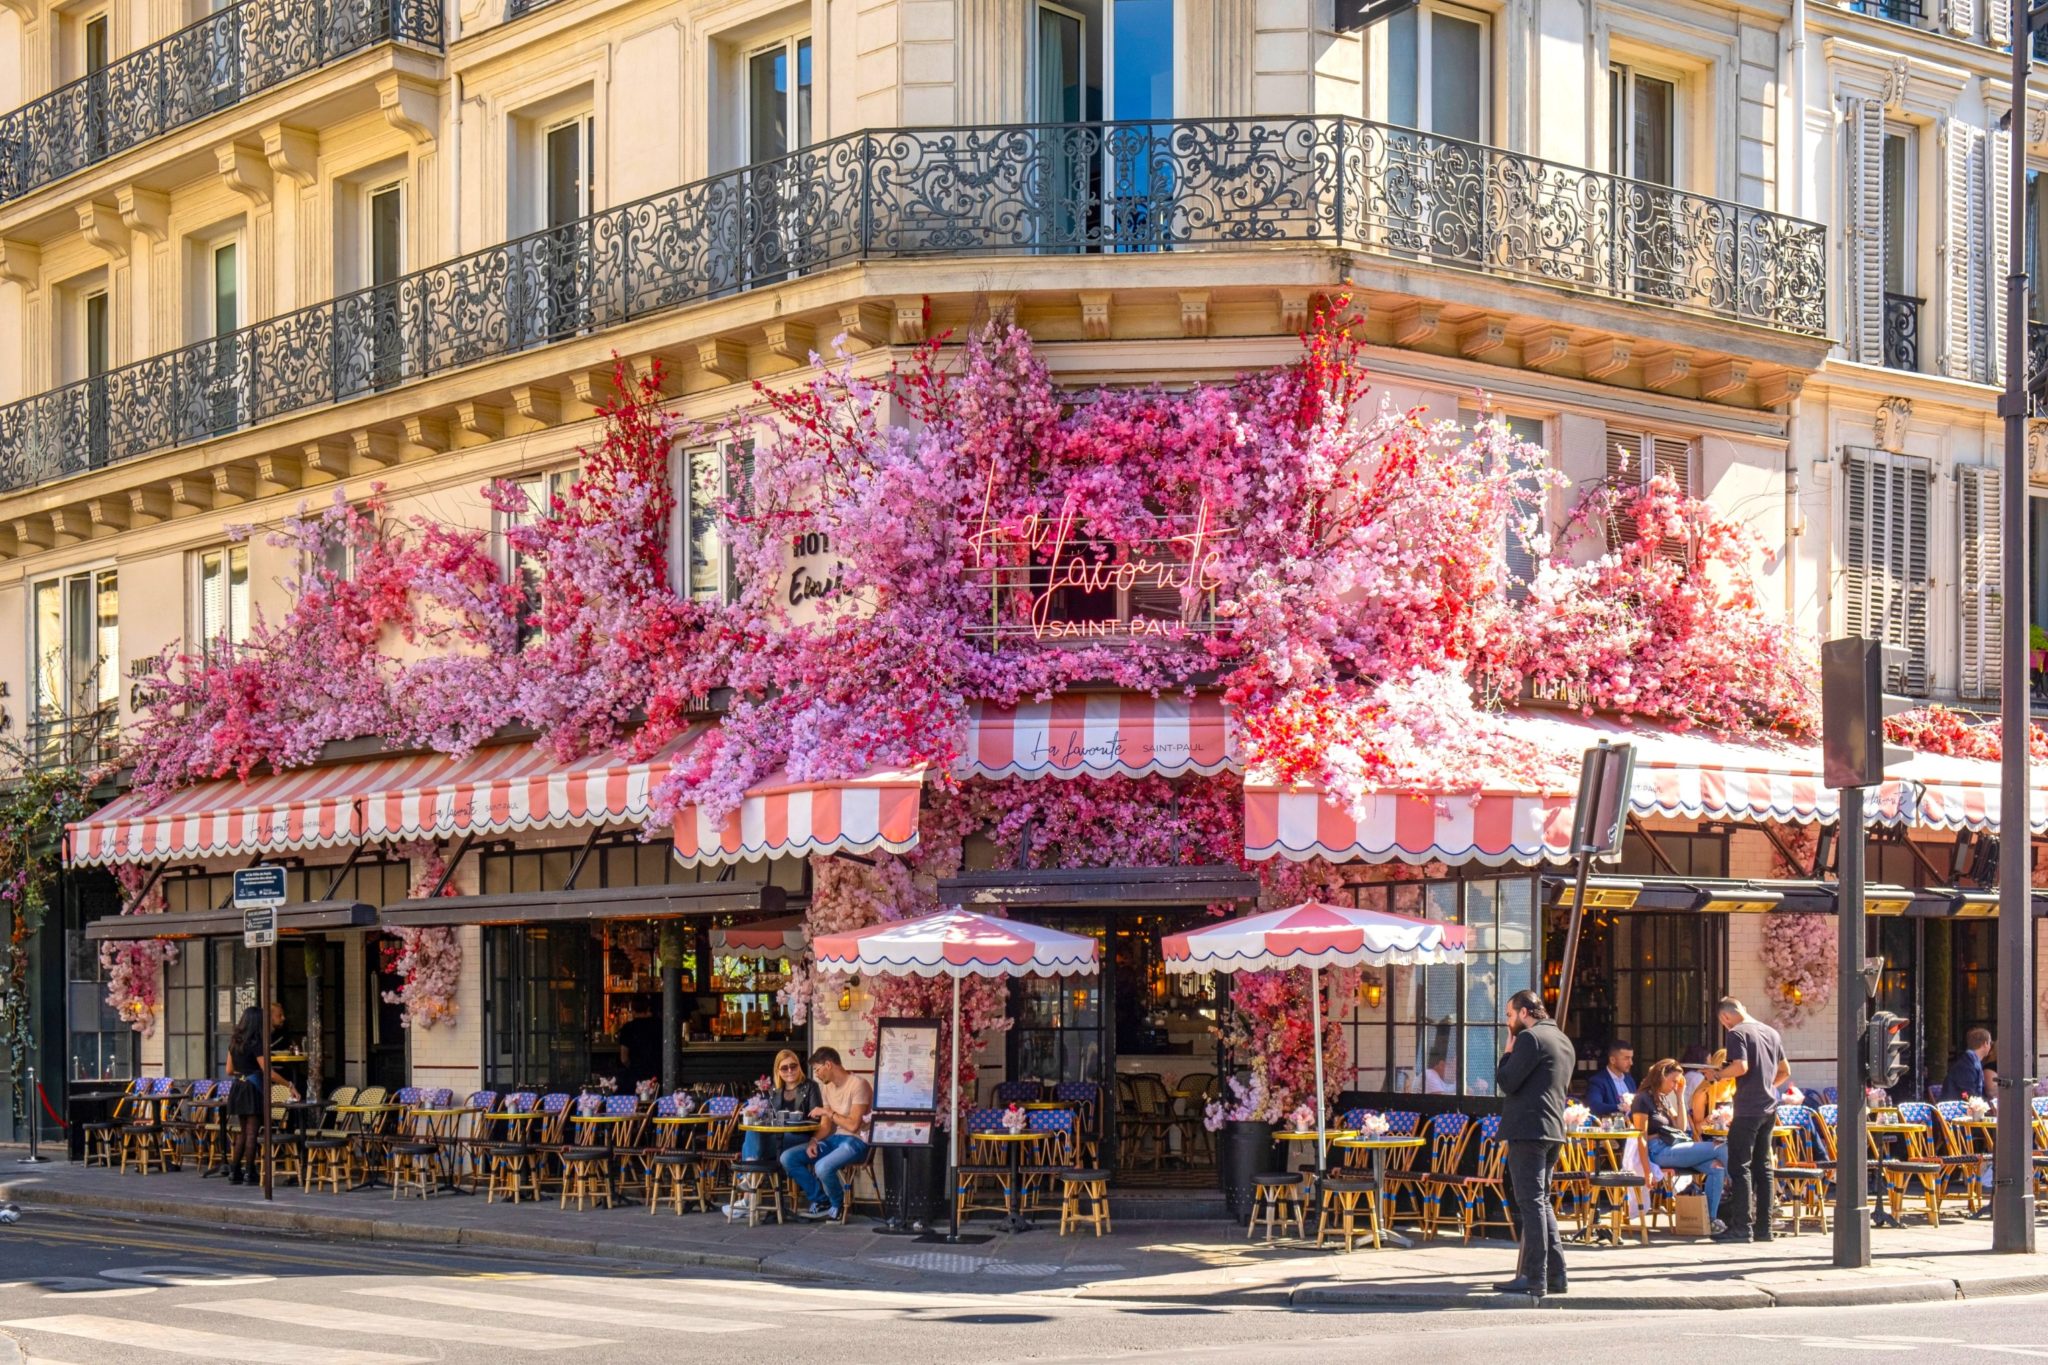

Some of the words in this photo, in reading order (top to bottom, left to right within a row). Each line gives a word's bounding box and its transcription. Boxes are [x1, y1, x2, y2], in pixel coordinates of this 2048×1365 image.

[968, 458, 1051, 568] La
[1049, 619, 1195, 637] SAINT-PAUL
[1030, 731, 1060, 761] La
[1061, 730, 1128, 767] favorite
[1142, 743, 1204, 753] SAINT-PAUL
